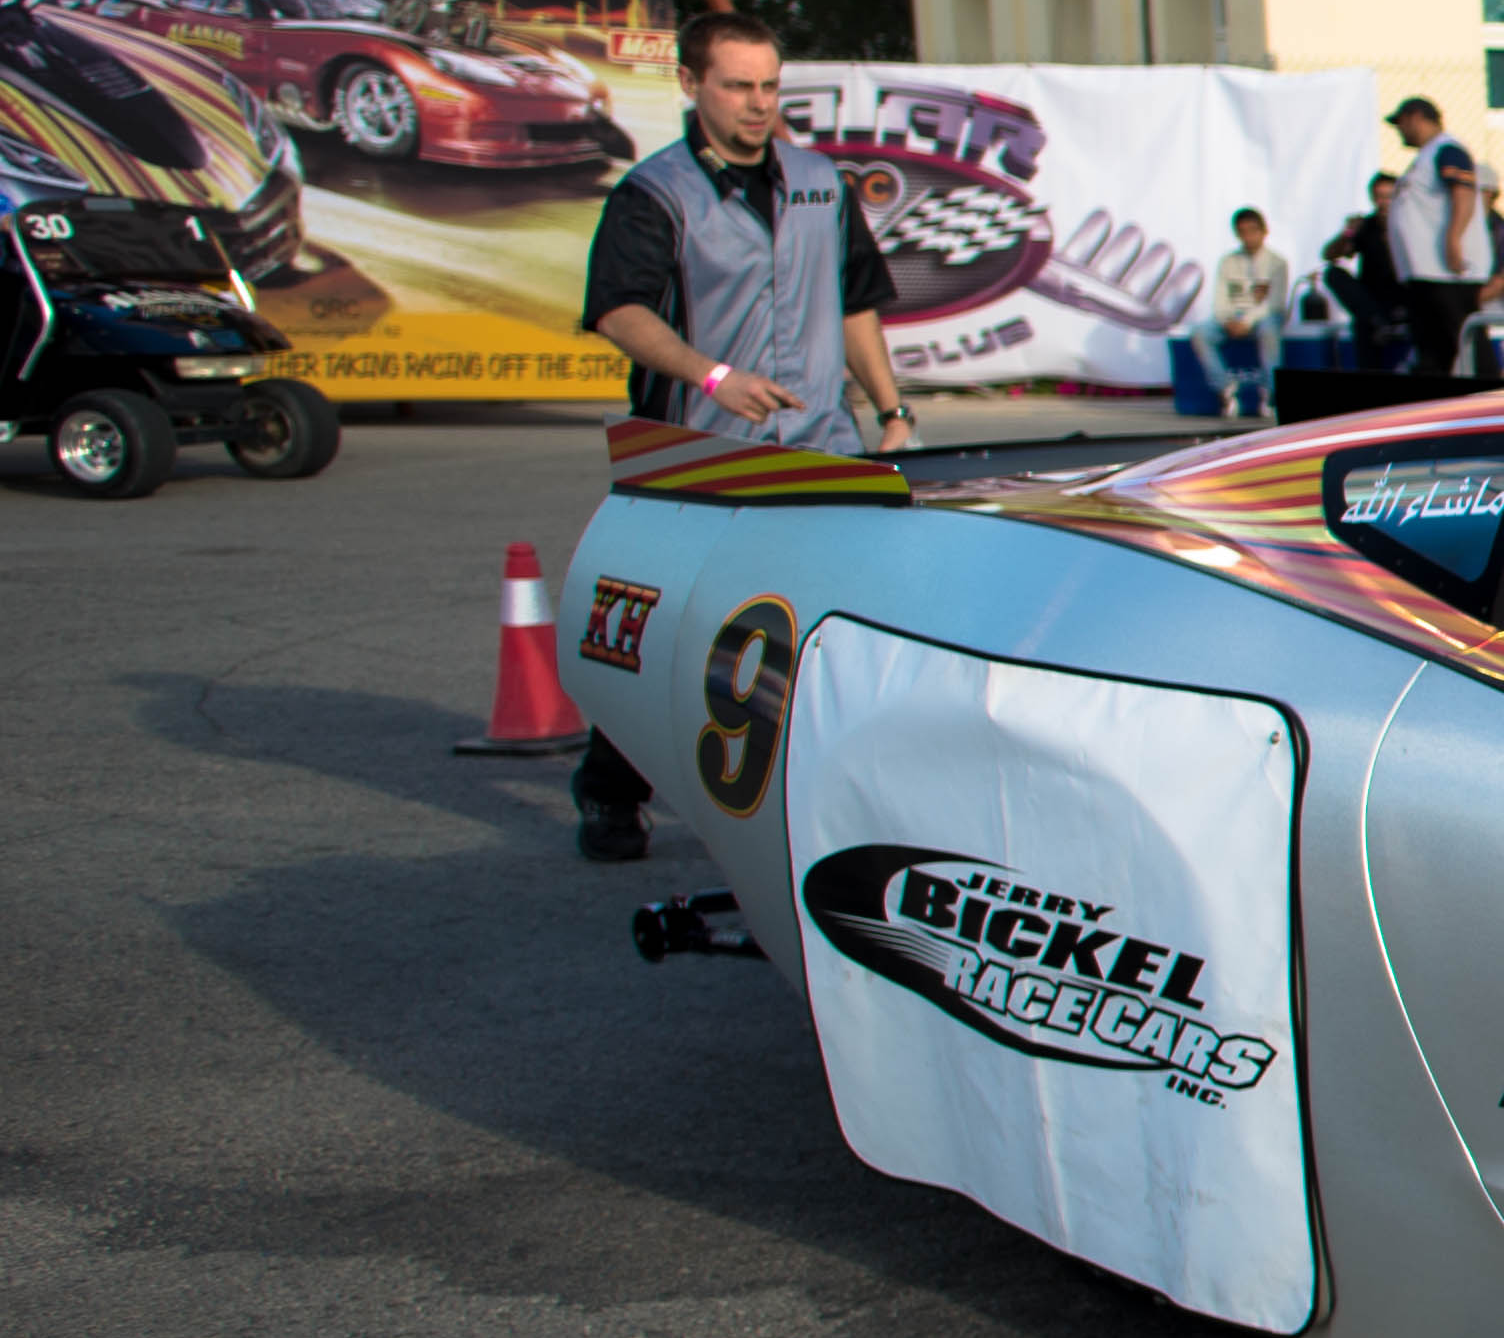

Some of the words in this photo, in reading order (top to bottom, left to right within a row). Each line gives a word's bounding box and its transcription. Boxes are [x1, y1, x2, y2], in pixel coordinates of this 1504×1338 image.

[779, 85, 1047, 183] ATAR
[25, 213, 74, 240] 30
[790, 188, 837, 205] AAP
[266, 351, 319, 380] THER
[324, 351, 400, 381] TAKING
[403, 351, 484, 381] RACING
[486, 351, 529, 381] OFF
[534, 351, 576, 381] THE
[578, 352, 632, 382] STRE
[1339, 463, 1402, 525] الله
[578, 574, 662, 674] KH
[695, 592, 800, 819] 9
[956, 871, 1118, 923] JERRY
[898, 866, 1207, 1011] BICKEL
[943, 948, 1092, 1038] RACE
[1091, 980, 1278, 1094] CARS
[1163, 1073, 1228, 1110] INC.
